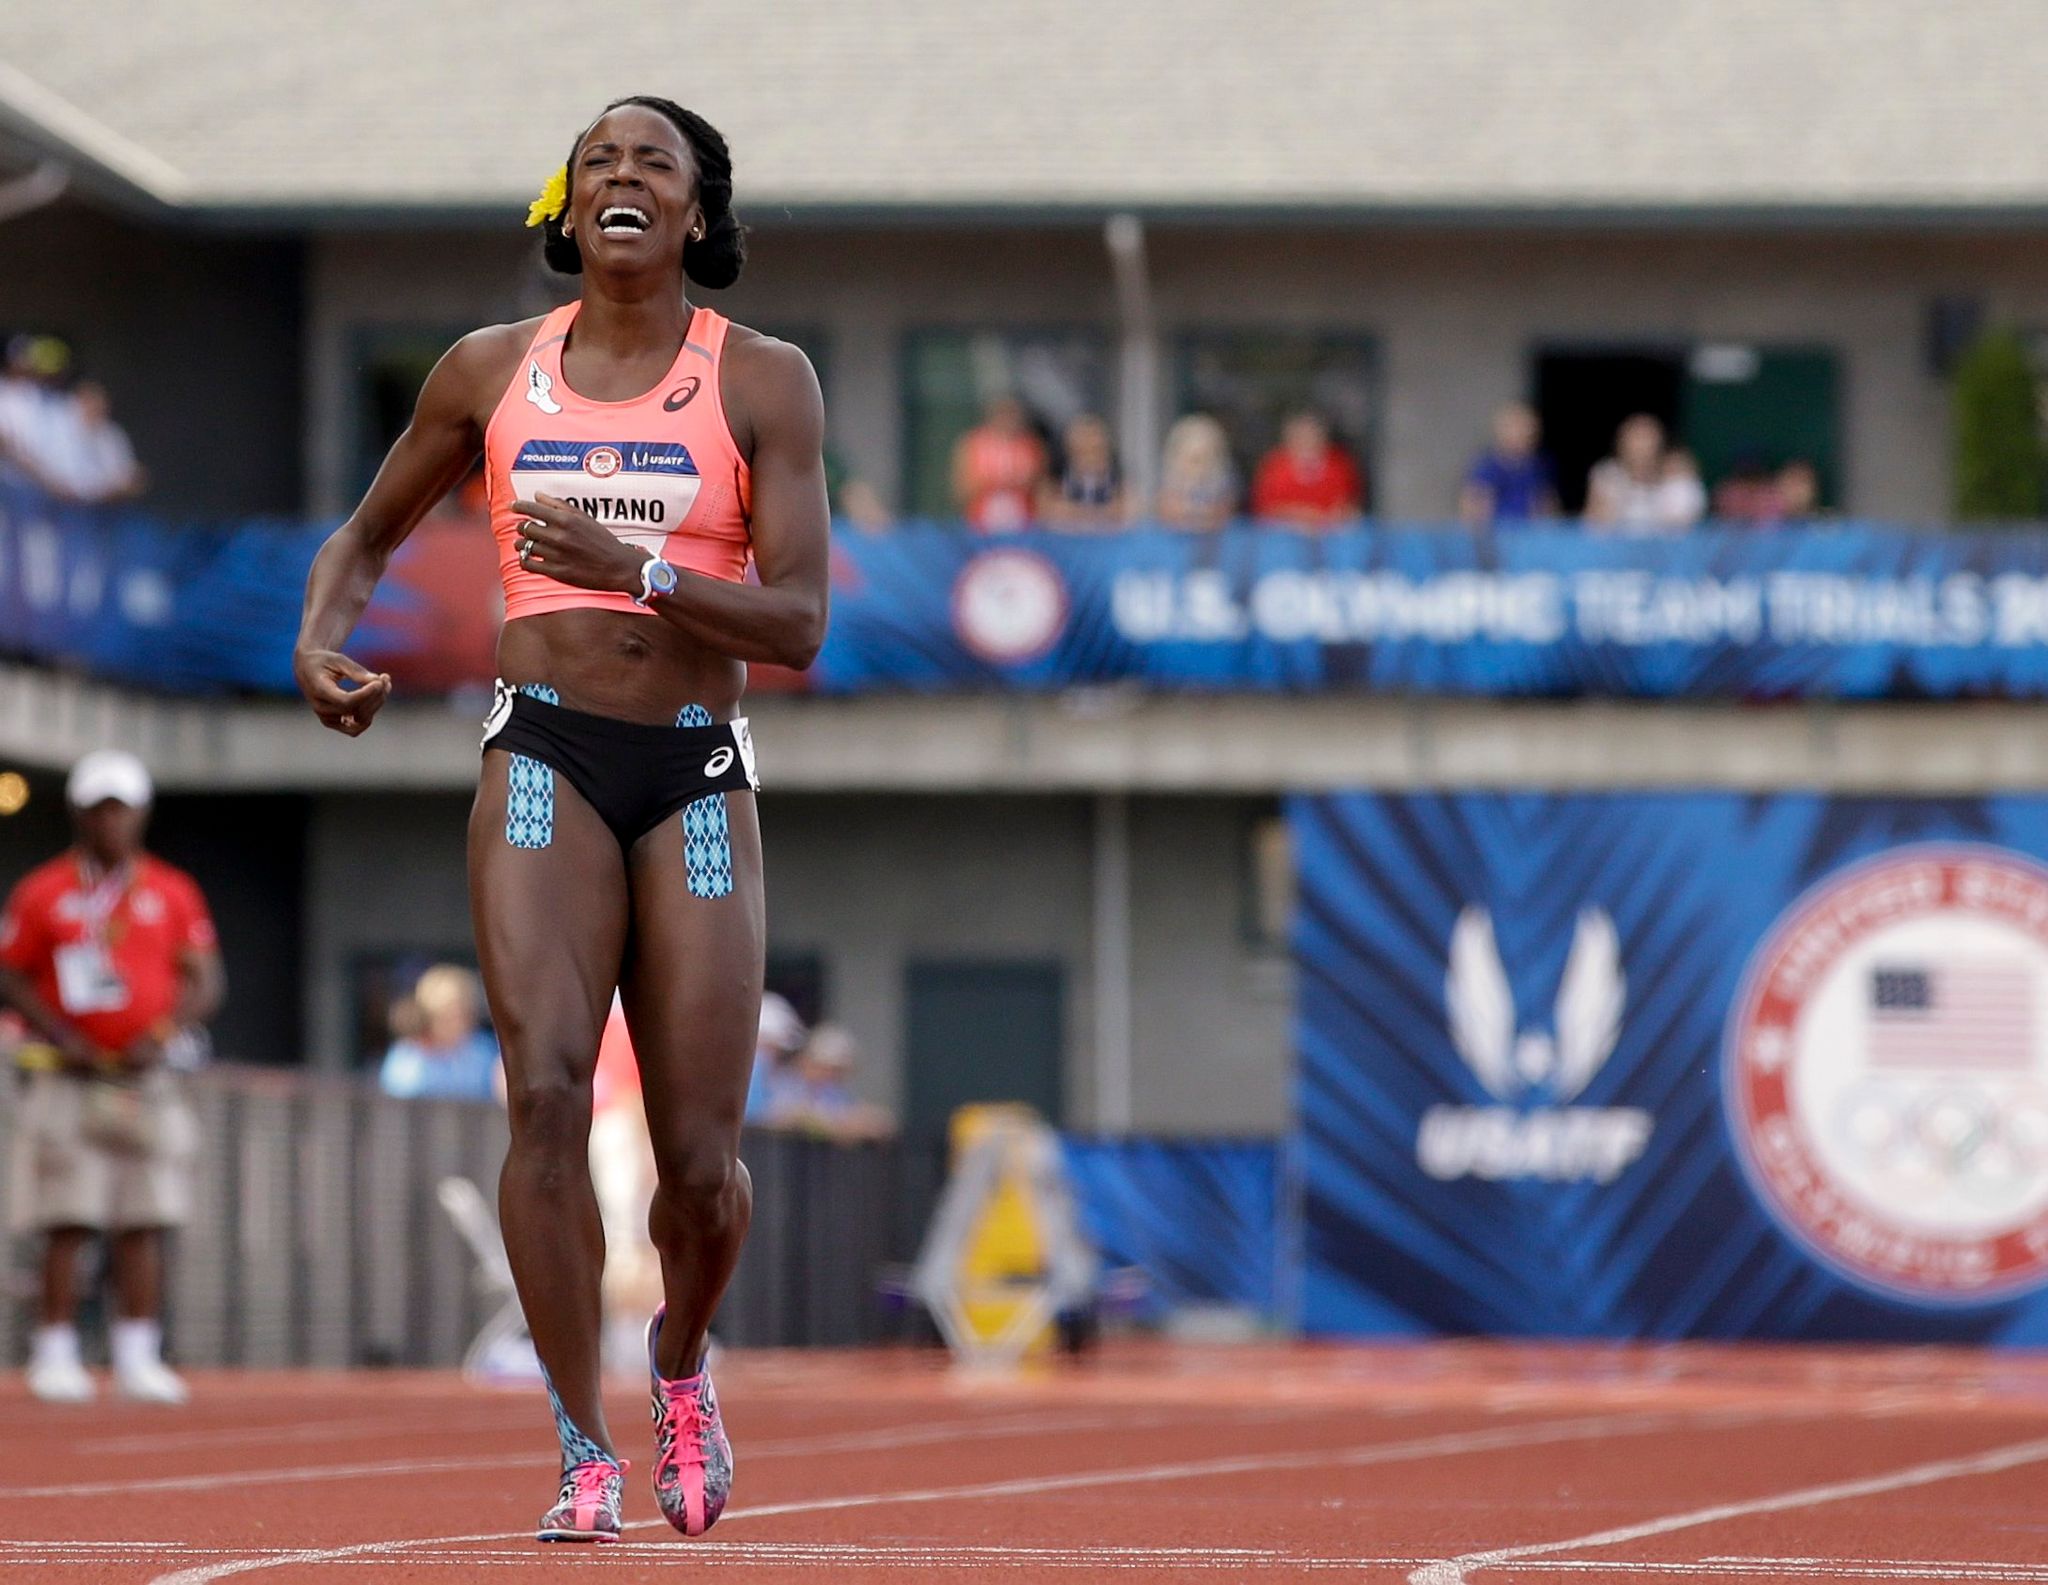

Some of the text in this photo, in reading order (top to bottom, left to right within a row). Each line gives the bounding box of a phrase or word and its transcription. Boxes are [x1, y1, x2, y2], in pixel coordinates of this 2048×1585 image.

[649, 455, 685, 466] USATF
[565, 496, 665, 523] ONTANO
[1250, 568, 1568, 645] OLYMPIC
[1572, 569, 1763, 647] TEAM
[1766, 569, 1986, 647] TRIALS
